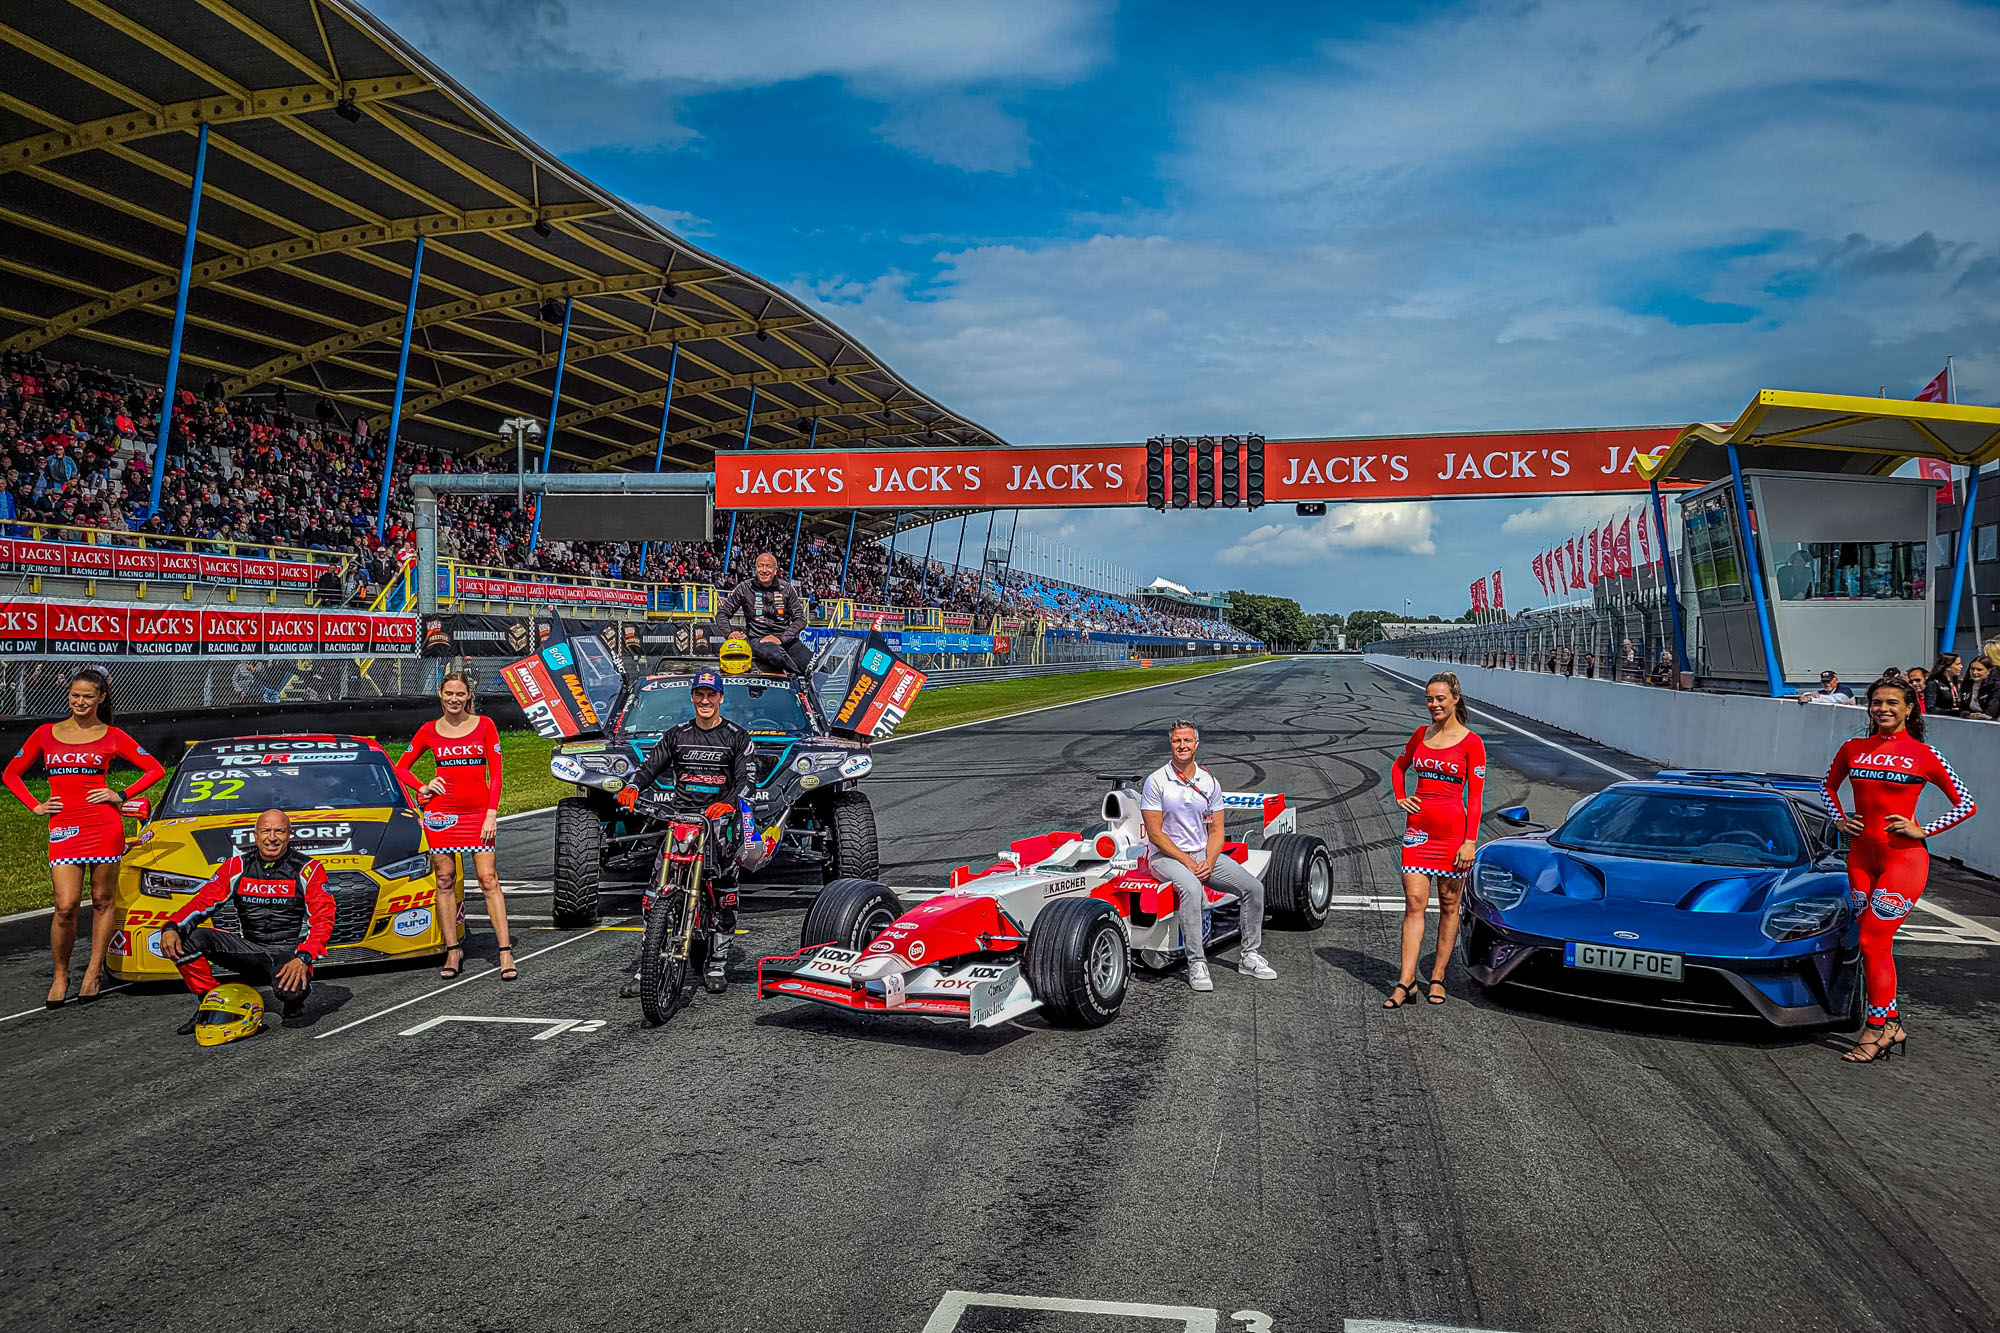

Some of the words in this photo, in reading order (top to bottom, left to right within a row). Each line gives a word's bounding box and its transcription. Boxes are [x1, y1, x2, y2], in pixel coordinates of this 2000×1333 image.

[1282, 454, 1410, 485] JACK'S
[1438, 449, 1571, 480] JACK'S
[735, 467, 844, 494] JACK'S
[868, 465, 981, 493] JACK'S
[1006, 463, 1124, 490] JACK'S
[20, 547, 61, 561] JACK'S
[71, 551, 110, 564] JACK'S
[118, 554, 155, 567] JACK'S
[162, 557, 197, 569] JACK'S
[205, 561, 238, 573] JACK'S
[244, 564, 274, 576] JACK'S
[281, 566, 308, 578] JACK'S
[50, 566, 61, 574] DAY
[72, 567, 97, 575] RACING
[0, 611, 38, 631] CK'S
[55, 614, 120, 633] JACK'S
[136, 617, 194, 635] JACK'S
[208, 618, 258, 635] JACK'S
[269, 620, 314, 636] JACK'S
[325, 621, 367, 636] JACK'S
[376, 623, 413, 637] JACK'S
[17, 640, 37, 651] DAY
[56, 641, 96, 652] RACING
[99, 642, 119, 653] DAY
[137, 643, 173, 653] RACING
[174, 643, 193, 653] DAY
[208, 643, 239, 653] RACING
[241, 643, 257, 653] DAY
[269, 643, 297, 652] RACING
[299, 643, 314, 652] DAY
[325, 643, 350, 652] RACING
[351, 643, 364, 652] DAY
[375, 643, 398, 652] RACING
[400, 643, 412, 652] DAY
[549, 647, 568, 665] BOTS
[516, 667, 541, 698] MOTUL
[892, 674, 914, 703] MOTUL
[562, 673, 598, 724] MAXXIS
[837, 673, 873, 724] MAXXIS
[523, 705, 561, 738] 347
[873, 707, 903, 738] 347
[212, 742, 359, 754] TRICORP
[437, 745, 484, 758] JACK'S
[46, 752, 103, 766] JACK'S
[216, 753, 291, 766] TCR
[291, 753, 356, 761] Europe
[1412, 757, 1459, 774] JACK'S
[1854, 752, 1914, 769] JACK'S
[552, 760, 581, 778] eurol
[845, 758, 872, 775] eurol
[1886, 772, 1909, 783] DAY
[182, 779, 245, 803] 32
[242, 882, 290, 895] JACK'S
[1049, 877, 1086, 894] KÄRCHER
[1119, 880, 1160, 891] DENSO
[242, 896, 269, 905] RACING
[271, 897, 288, 905] DAY
[387, 889, 436, 913] DH
[922, 906, 944, 914] 17
[397, 916, 429, 930] eurol
[882, 930, 909, 939] intel
[817, 948, 856, 963] KDDI
[910, 946, 923, 956] Esso
[810, 960, 849, 975] TOYO
[1582, 947, 1626, 967] GT17
[1632, 952, 1674, 976] FOE
[968, 967, 1004, 978] KDD
[975, 1006, 992, 1024] Time
[992, 1000, 1004, 1016] Inc.
